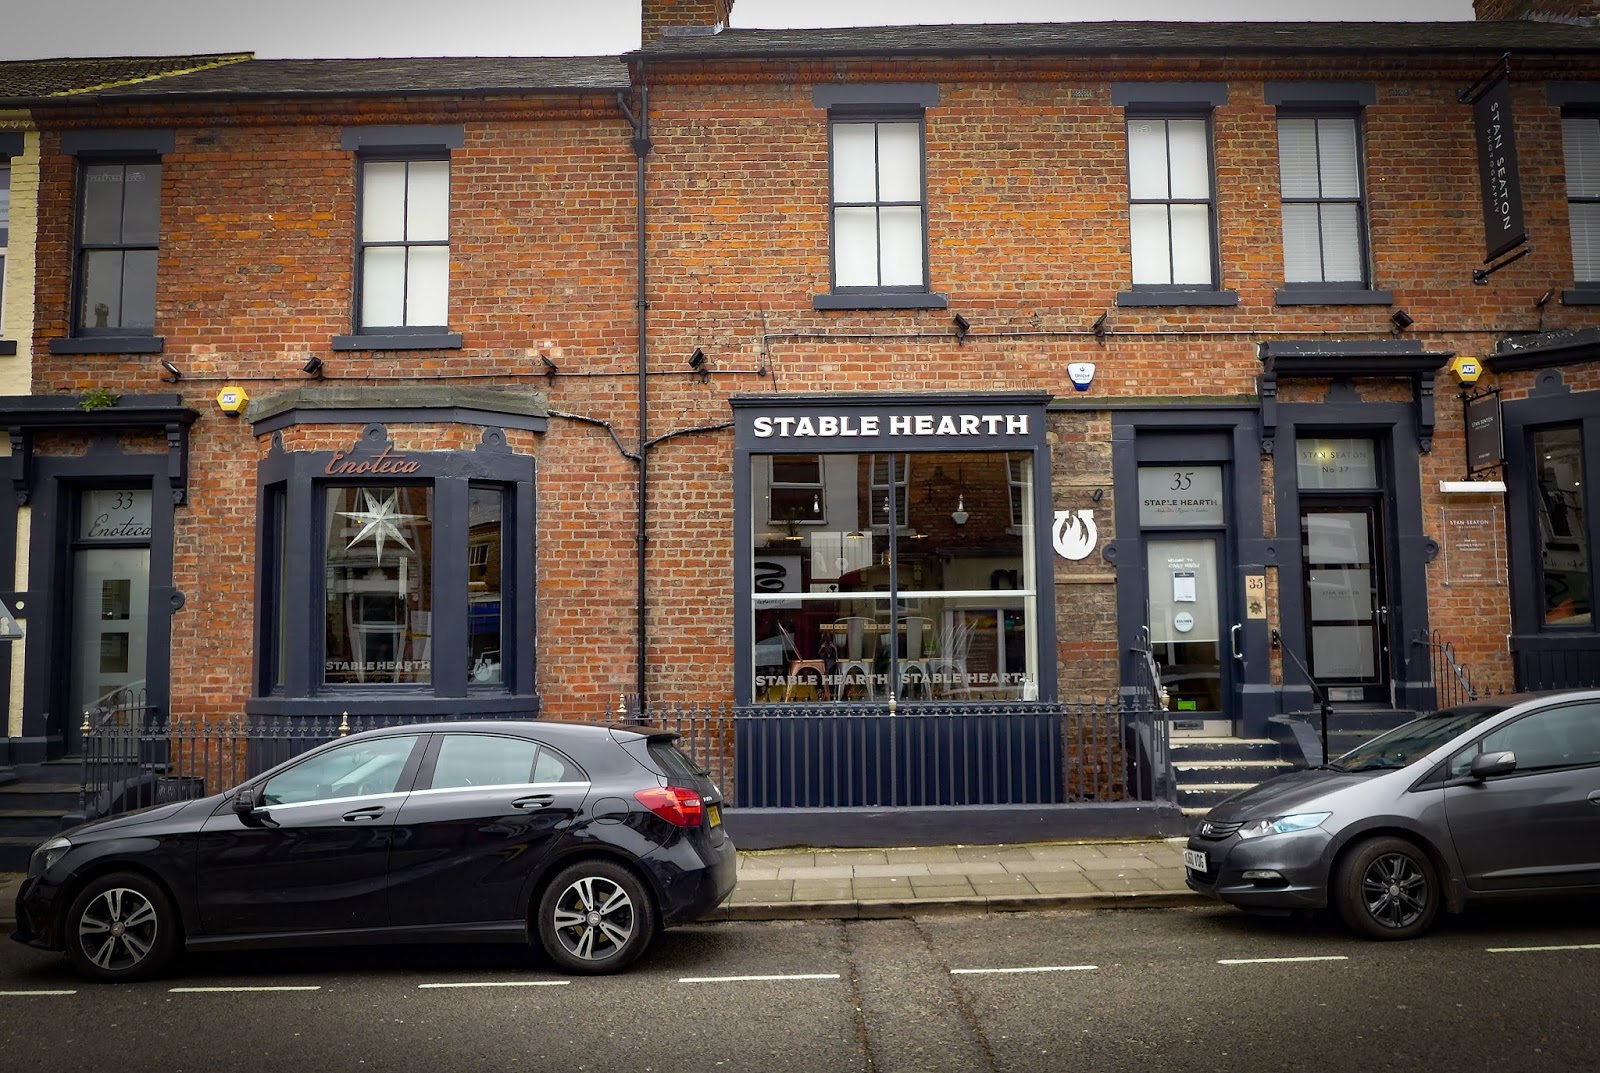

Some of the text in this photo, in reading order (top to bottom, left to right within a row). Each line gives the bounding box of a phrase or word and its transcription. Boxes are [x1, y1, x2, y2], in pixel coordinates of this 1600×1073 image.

[1486, 128, 1499, 212] PHOTOGRAPHY
[1491, 102, 1512, 230] STAN SEATON
[1462, 364, 1475, 374] ADT
[223, 394, 236, 403] ADT
[753, 414, 1030, 437] STABLE HEARTH
[324, 440, 421, 474] Enoteca
[1303, 451, 1366, 459] STAN SEATON
[1170, 471, 1194, 491] 35
[112, 491, 133, 510] 33
[88, 513, 151, 537] Enoteca
[1249, 578, 1263, 589] 35
[326, 660, 430, 670] STABLE HEARTH
[755, 674, 888, 686] STABLE HEARTH
[901, 673, 962, 684] STABLE
